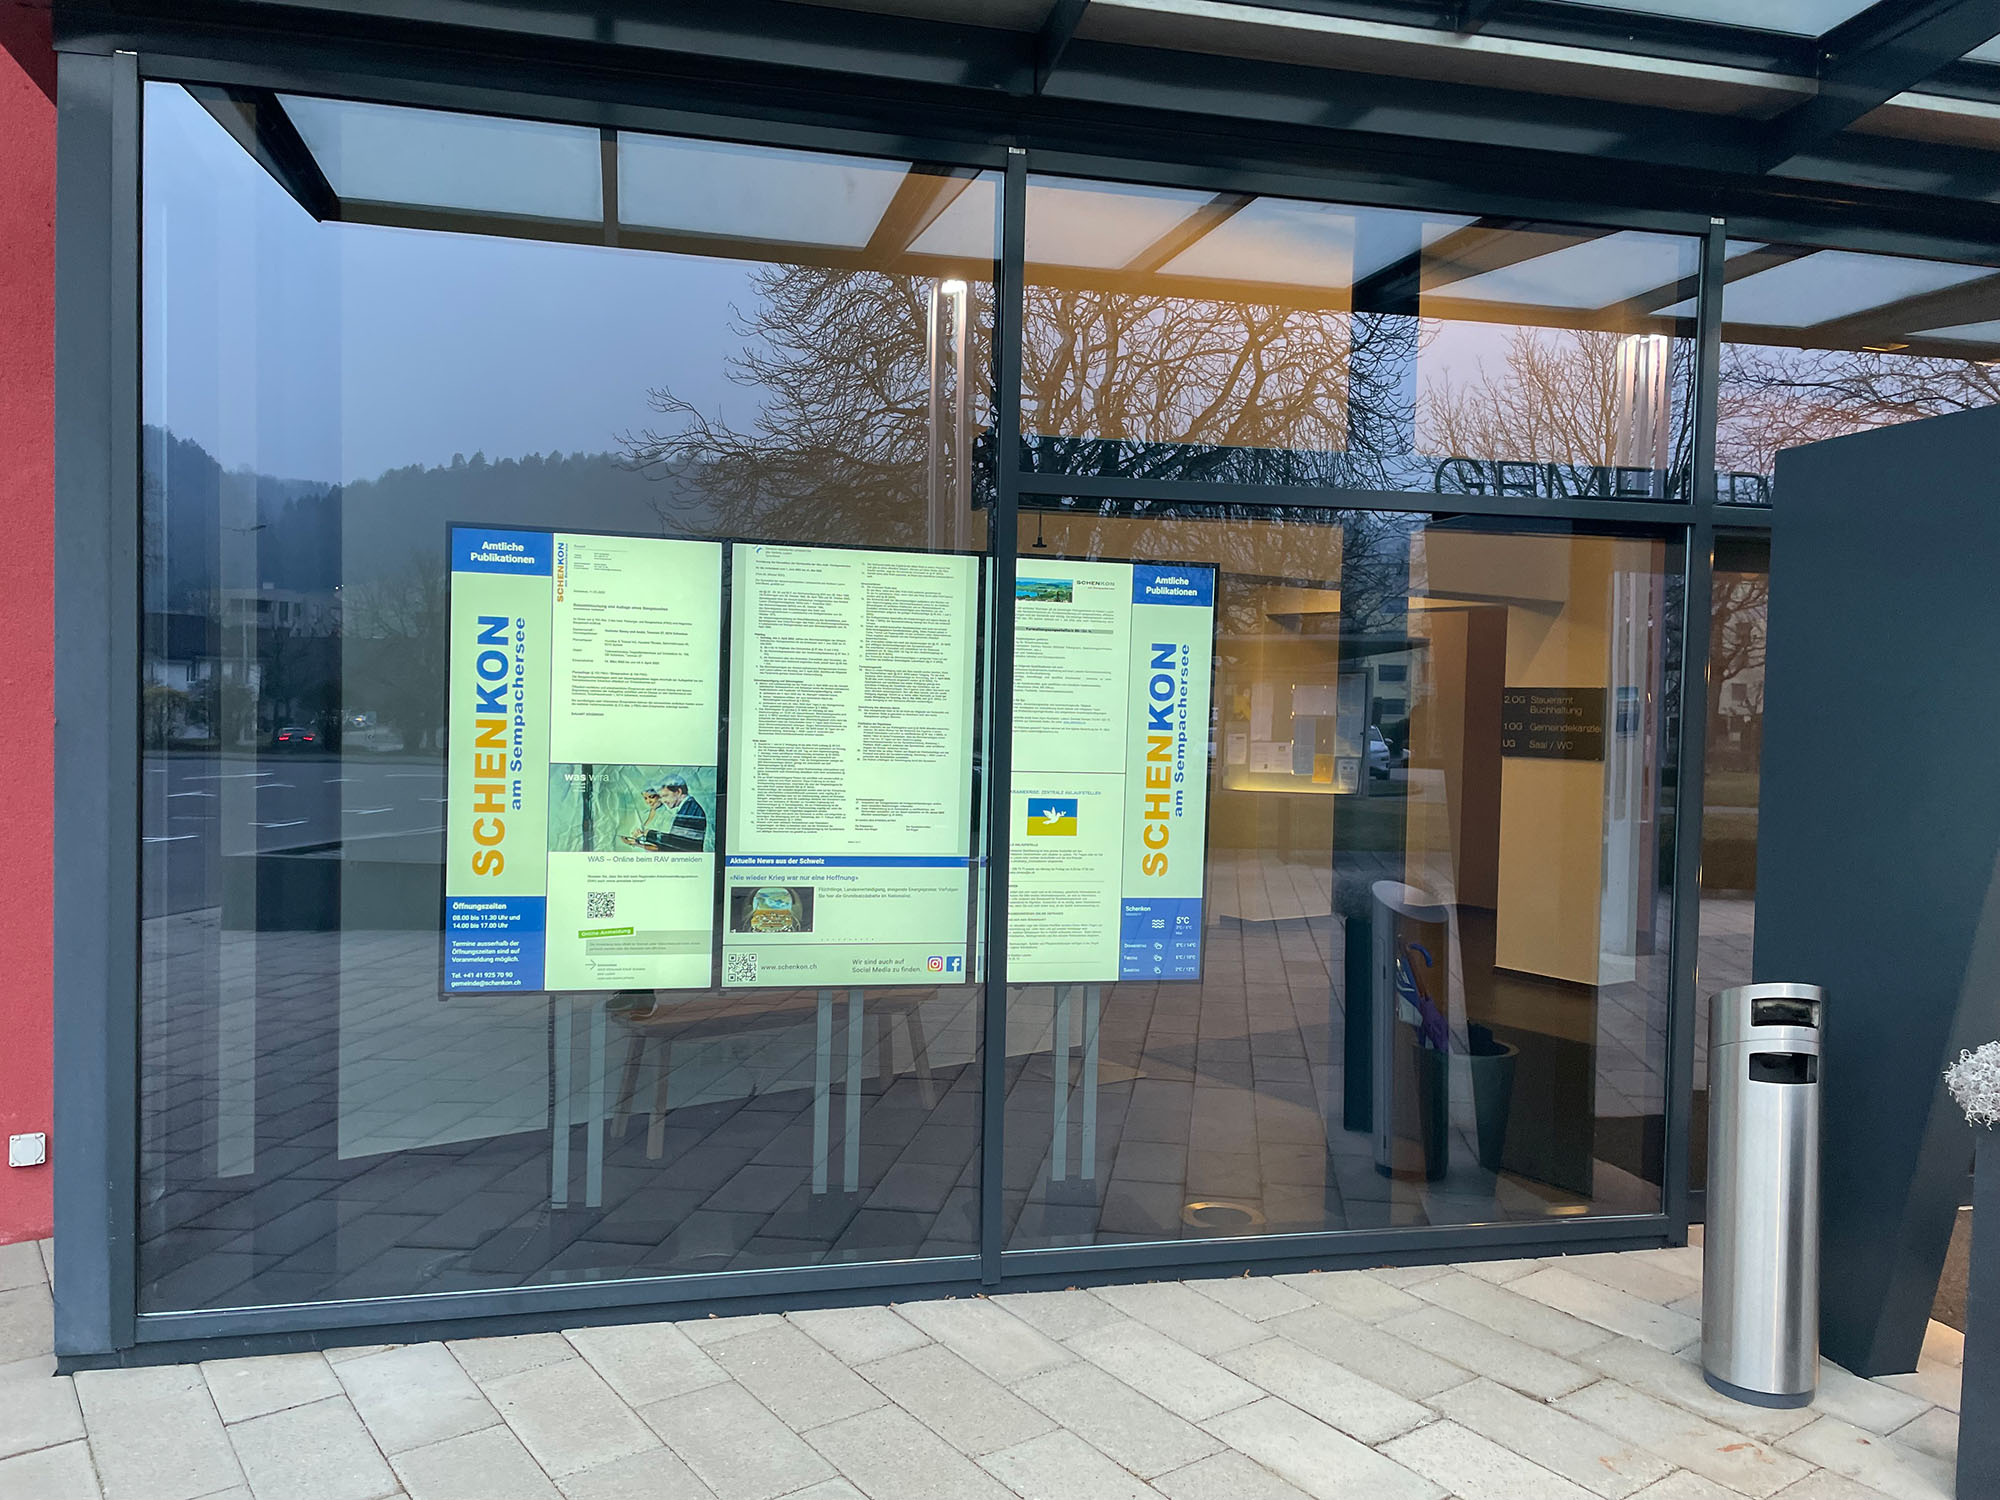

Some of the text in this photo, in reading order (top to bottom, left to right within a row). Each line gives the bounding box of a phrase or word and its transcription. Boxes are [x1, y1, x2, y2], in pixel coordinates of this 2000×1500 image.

[482, 541, 524, 552] Amtliche
[470, 552, 535, 564] Publikationen
[557, 542, 565, 602] SCHENKON
[1155, 576, 1189, 586] Amtliche
[1146, 586, 1198, 597] Publikationen
[510, 617, 526, 810] am Sempachersee
[1529, 705, 1583, 716] Buchhaltung
[1174, 644, 1190, 817] am Sempachersee
[471, 615, 510, 877] SCHENKON
[1502, 739, 1516, 747] UG
[1528, 740, 1548, 749] Saal
[1556, 741, 1573, 750] WC
[1142, 642, 1177, 877] SCHENKON
[452, 902, 507, 911] Öffnungszeiten
[1175, 916, 1190, 924] 5°C
[760, 962, 817, 971] www.schenkon.ch
[451, 980, 522, 988] gemeinde@schenkon.ch
